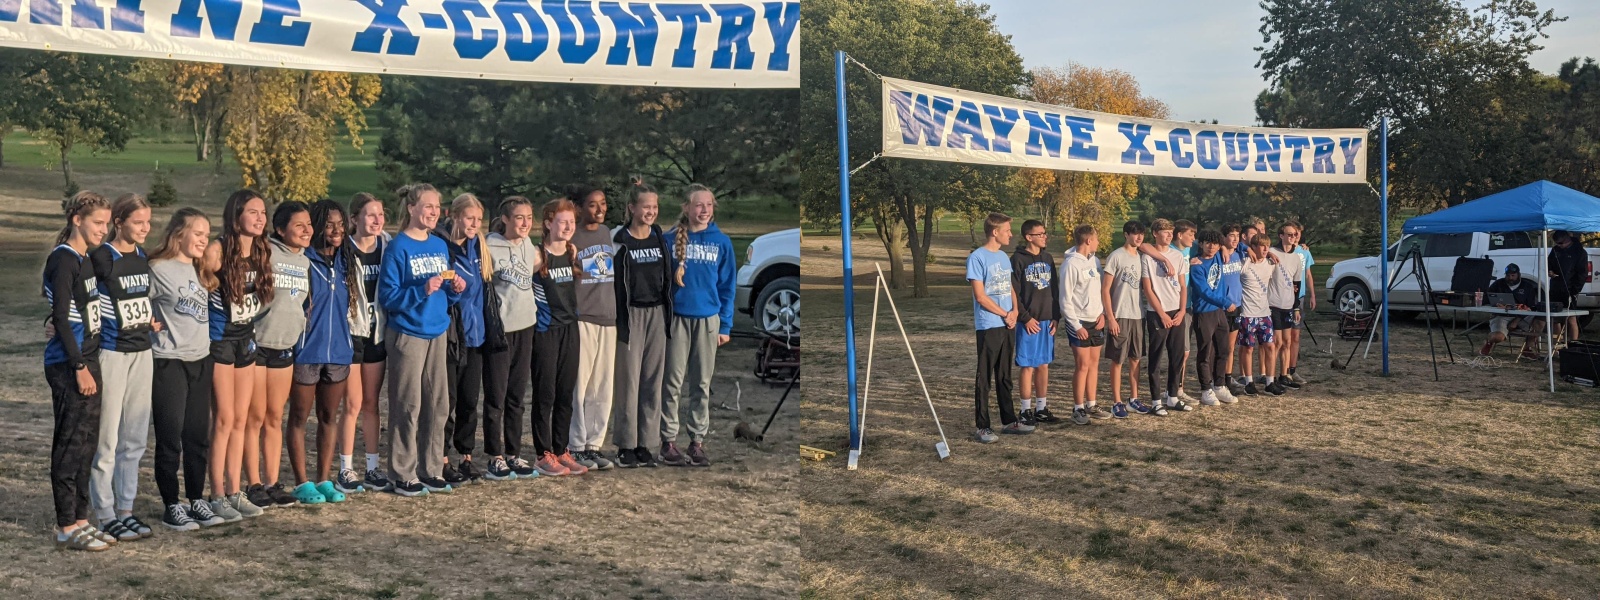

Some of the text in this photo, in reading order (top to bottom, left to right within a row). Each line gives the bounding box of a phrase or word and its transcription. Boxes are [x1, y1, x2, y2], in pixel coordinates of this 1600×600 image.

[351, 0, 800, 71] X-COUNTRY
[890, 90, 1362, 174] WAYNE X-COUNTRY
[629, 248, 663, 260] WAYNE
[548, 266, 573, 280] WAYN
[123, 300, 149, 321] 334
